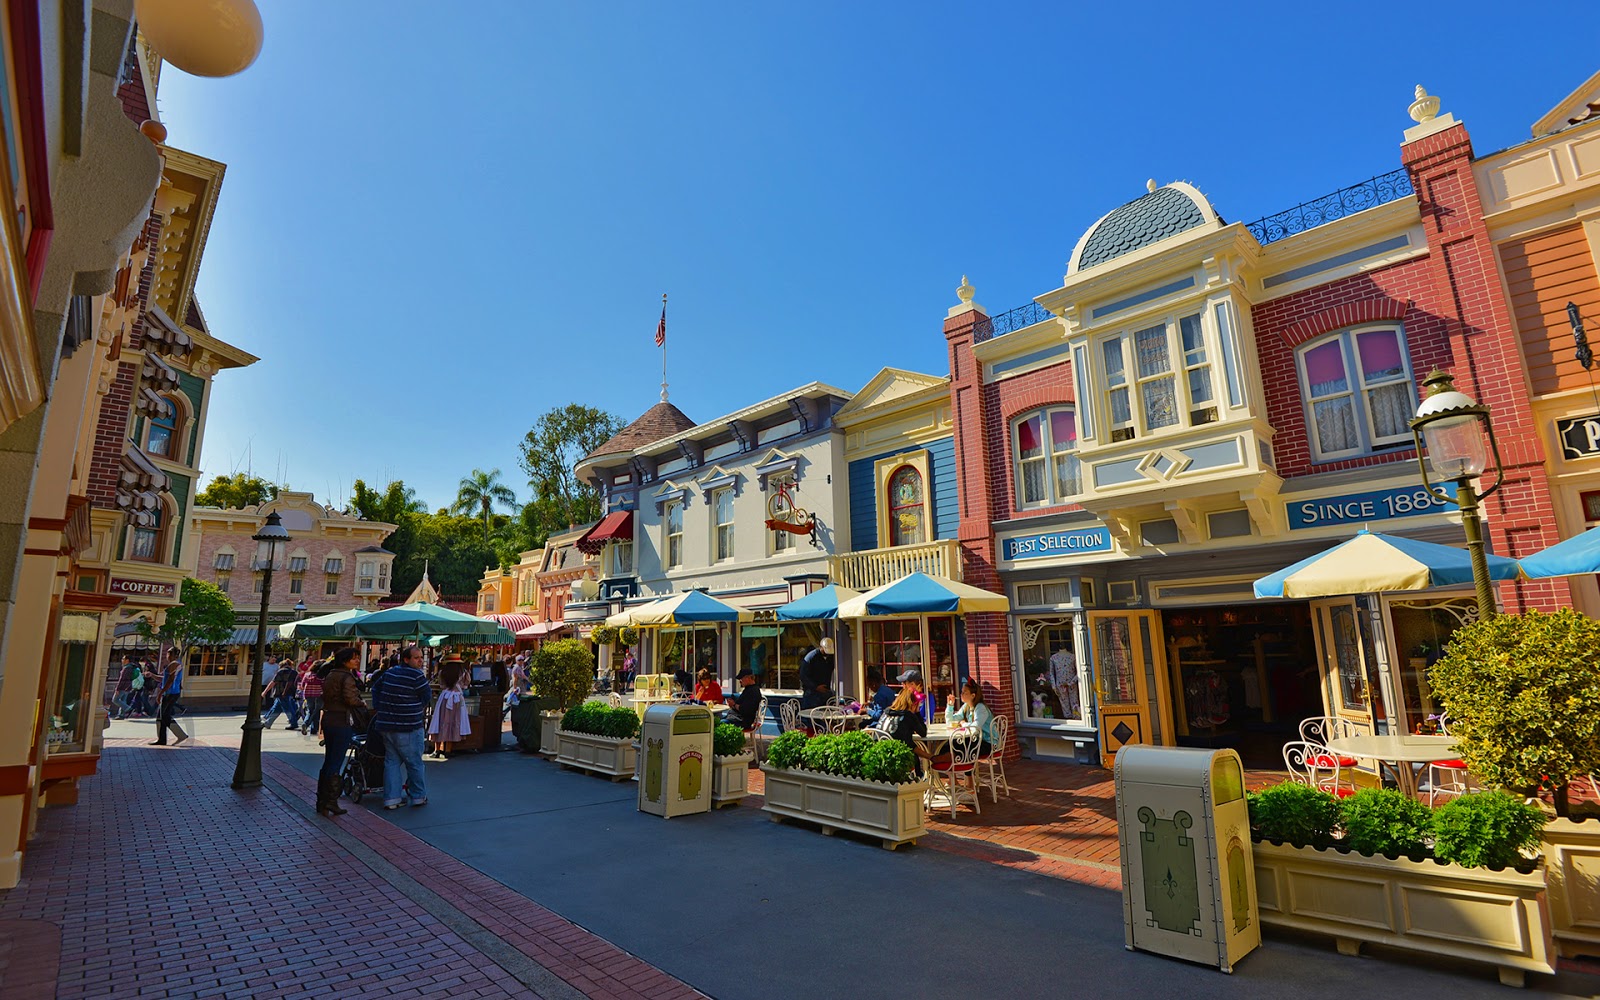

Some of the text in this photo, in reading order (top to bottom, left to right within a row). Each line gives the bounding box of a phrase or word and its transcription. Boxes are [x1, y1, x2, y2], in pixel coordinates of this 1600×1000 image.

[1301, 502, 1375, 523] SINCE
[1010, 532, 1103, 557] BEST SELECTION
[121, 581, 165, 594] COFFEE
